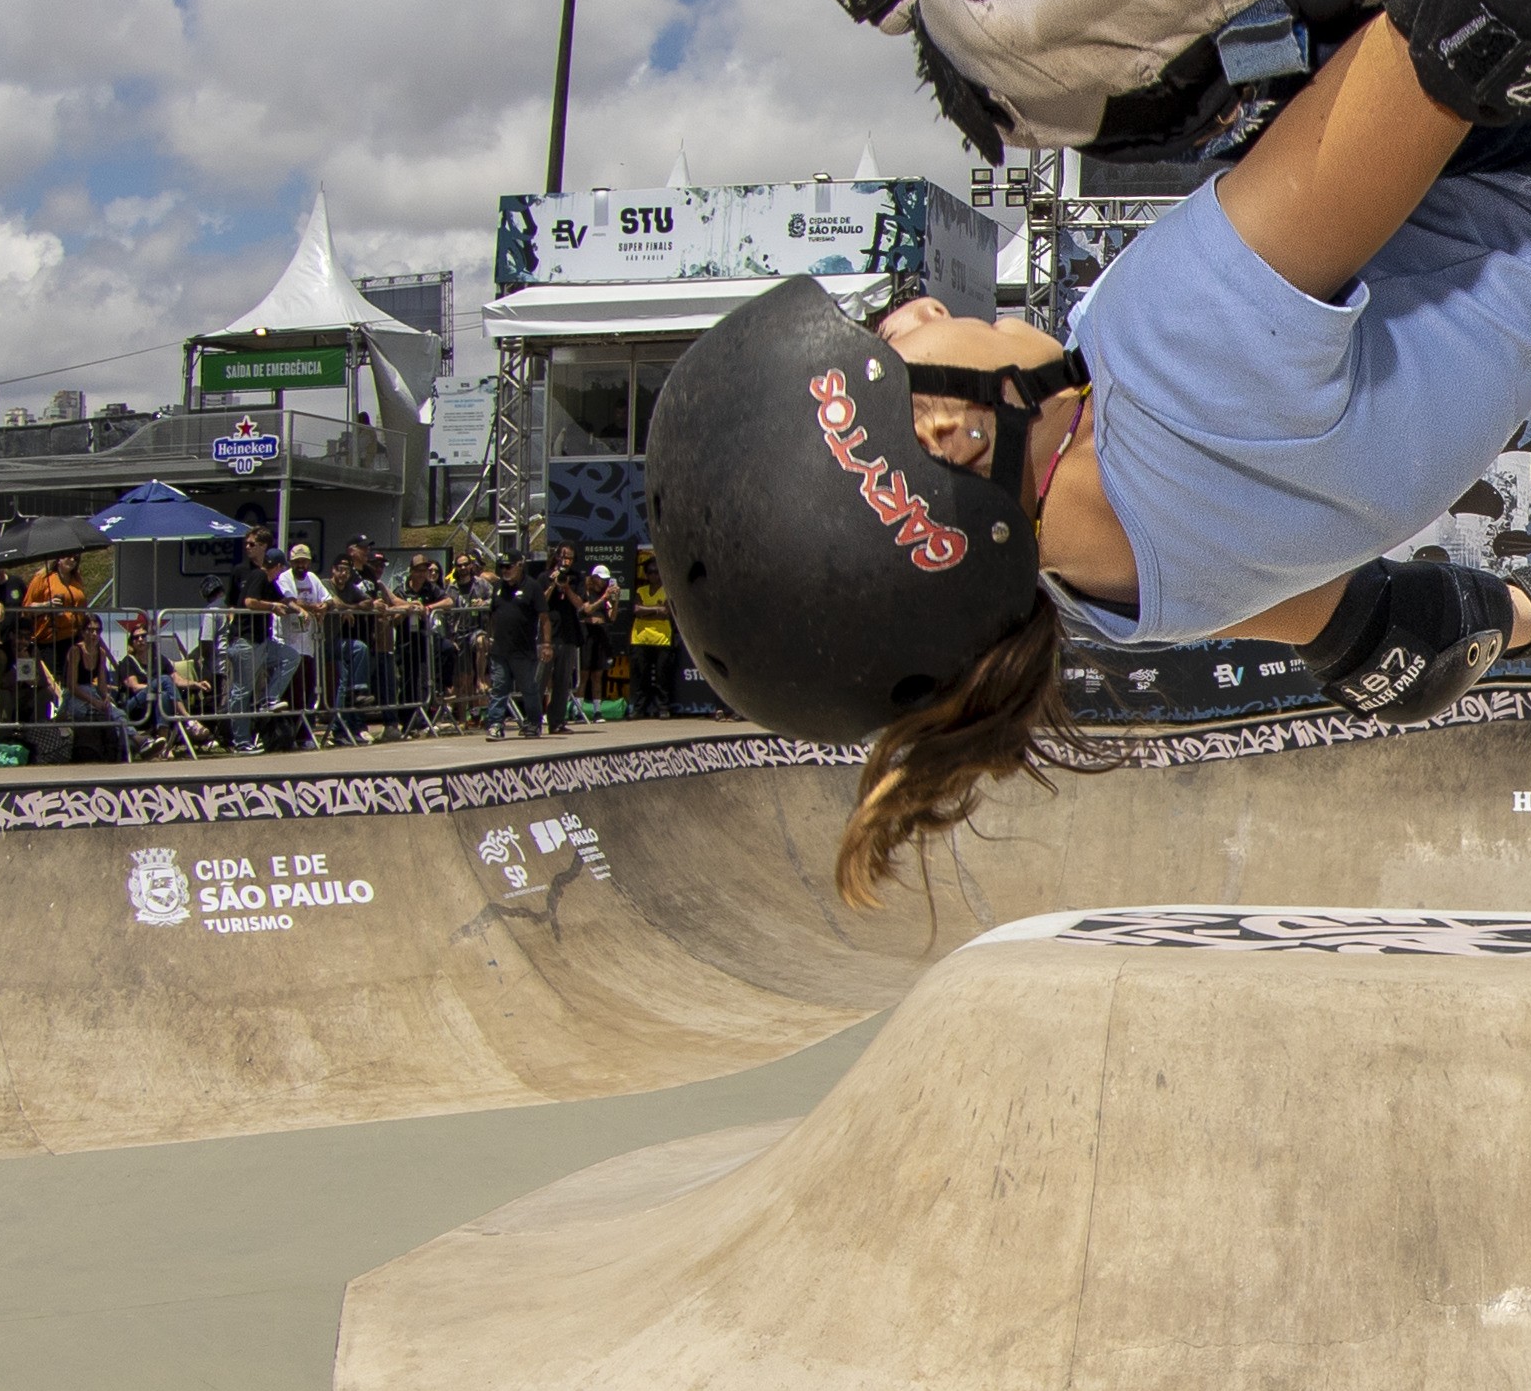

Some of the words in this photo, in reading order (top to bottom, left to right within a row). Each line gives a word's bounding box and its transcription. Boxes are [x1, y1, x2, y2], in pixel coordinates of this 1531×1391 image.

[620, 207, 674, 234] STU
[808, 224, 828, 234] SÃO
[831, 225, 863, 235] PAULO
[809, 217, 837, 225] CIDADE
[840, 217, 851, 225] DE
[552, 220, 588, 248] BV
[619, 242, 643, 253] SUPER
[646, 241, 673, 252] FINALS
[226, 361, 251, 379] SAÍDA
[253, 365, 264, 377] DE
[266, 359, 322, 376] EMERGÊNCIA
[218, 442, 273, 456] Heineken
[1259, 661, 1286, 676] STU
[293, 853, 328, 876] DE
[504, 864, 528, 888] SP
[200, 881, 266, 912] SÃO
[271, 879, 374, 908] PAULO
[204, 914, 294, 933] TURISMO
